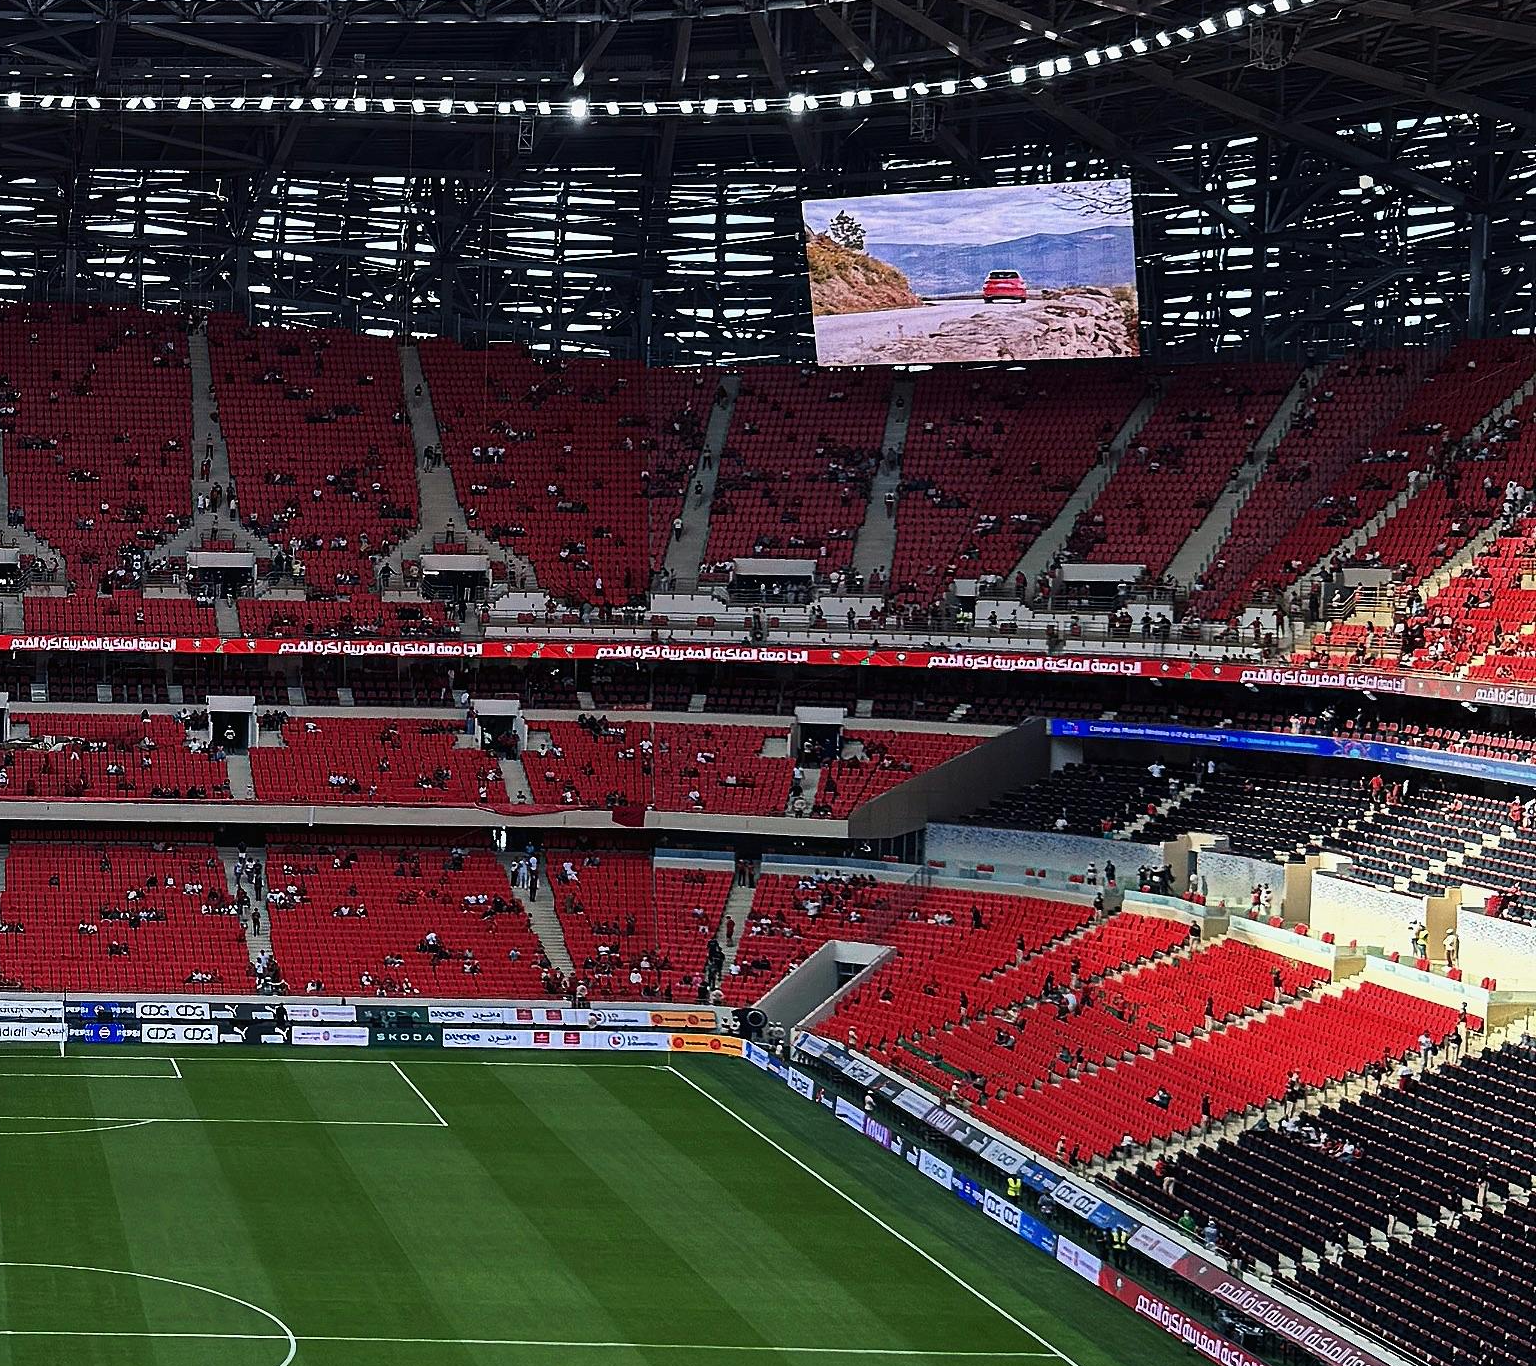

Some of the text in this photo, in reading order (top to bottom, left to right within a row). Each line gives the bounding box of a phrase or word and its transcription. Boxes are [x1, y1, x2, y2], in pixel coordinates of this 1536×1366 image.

[11, 637, 39, 650] القدم
[103, 637, 137, 651] الملكية
[279, 641, 314, 654] القدم
[392, 641, 435, 656] الملكية
[596, 646, 631, 659] القدم
[713, 647, 757, 662] الملكية
[928, 655, 962, 668] القدم
[1044, 657, 1090, 672] الملكية
[141, 1005, 170, 1017] CDG
[176, 1005, 205, 1017] CDG
[147, 1027, 176, 1040] CDG
[184, 1028, 212, 1041] CDG
